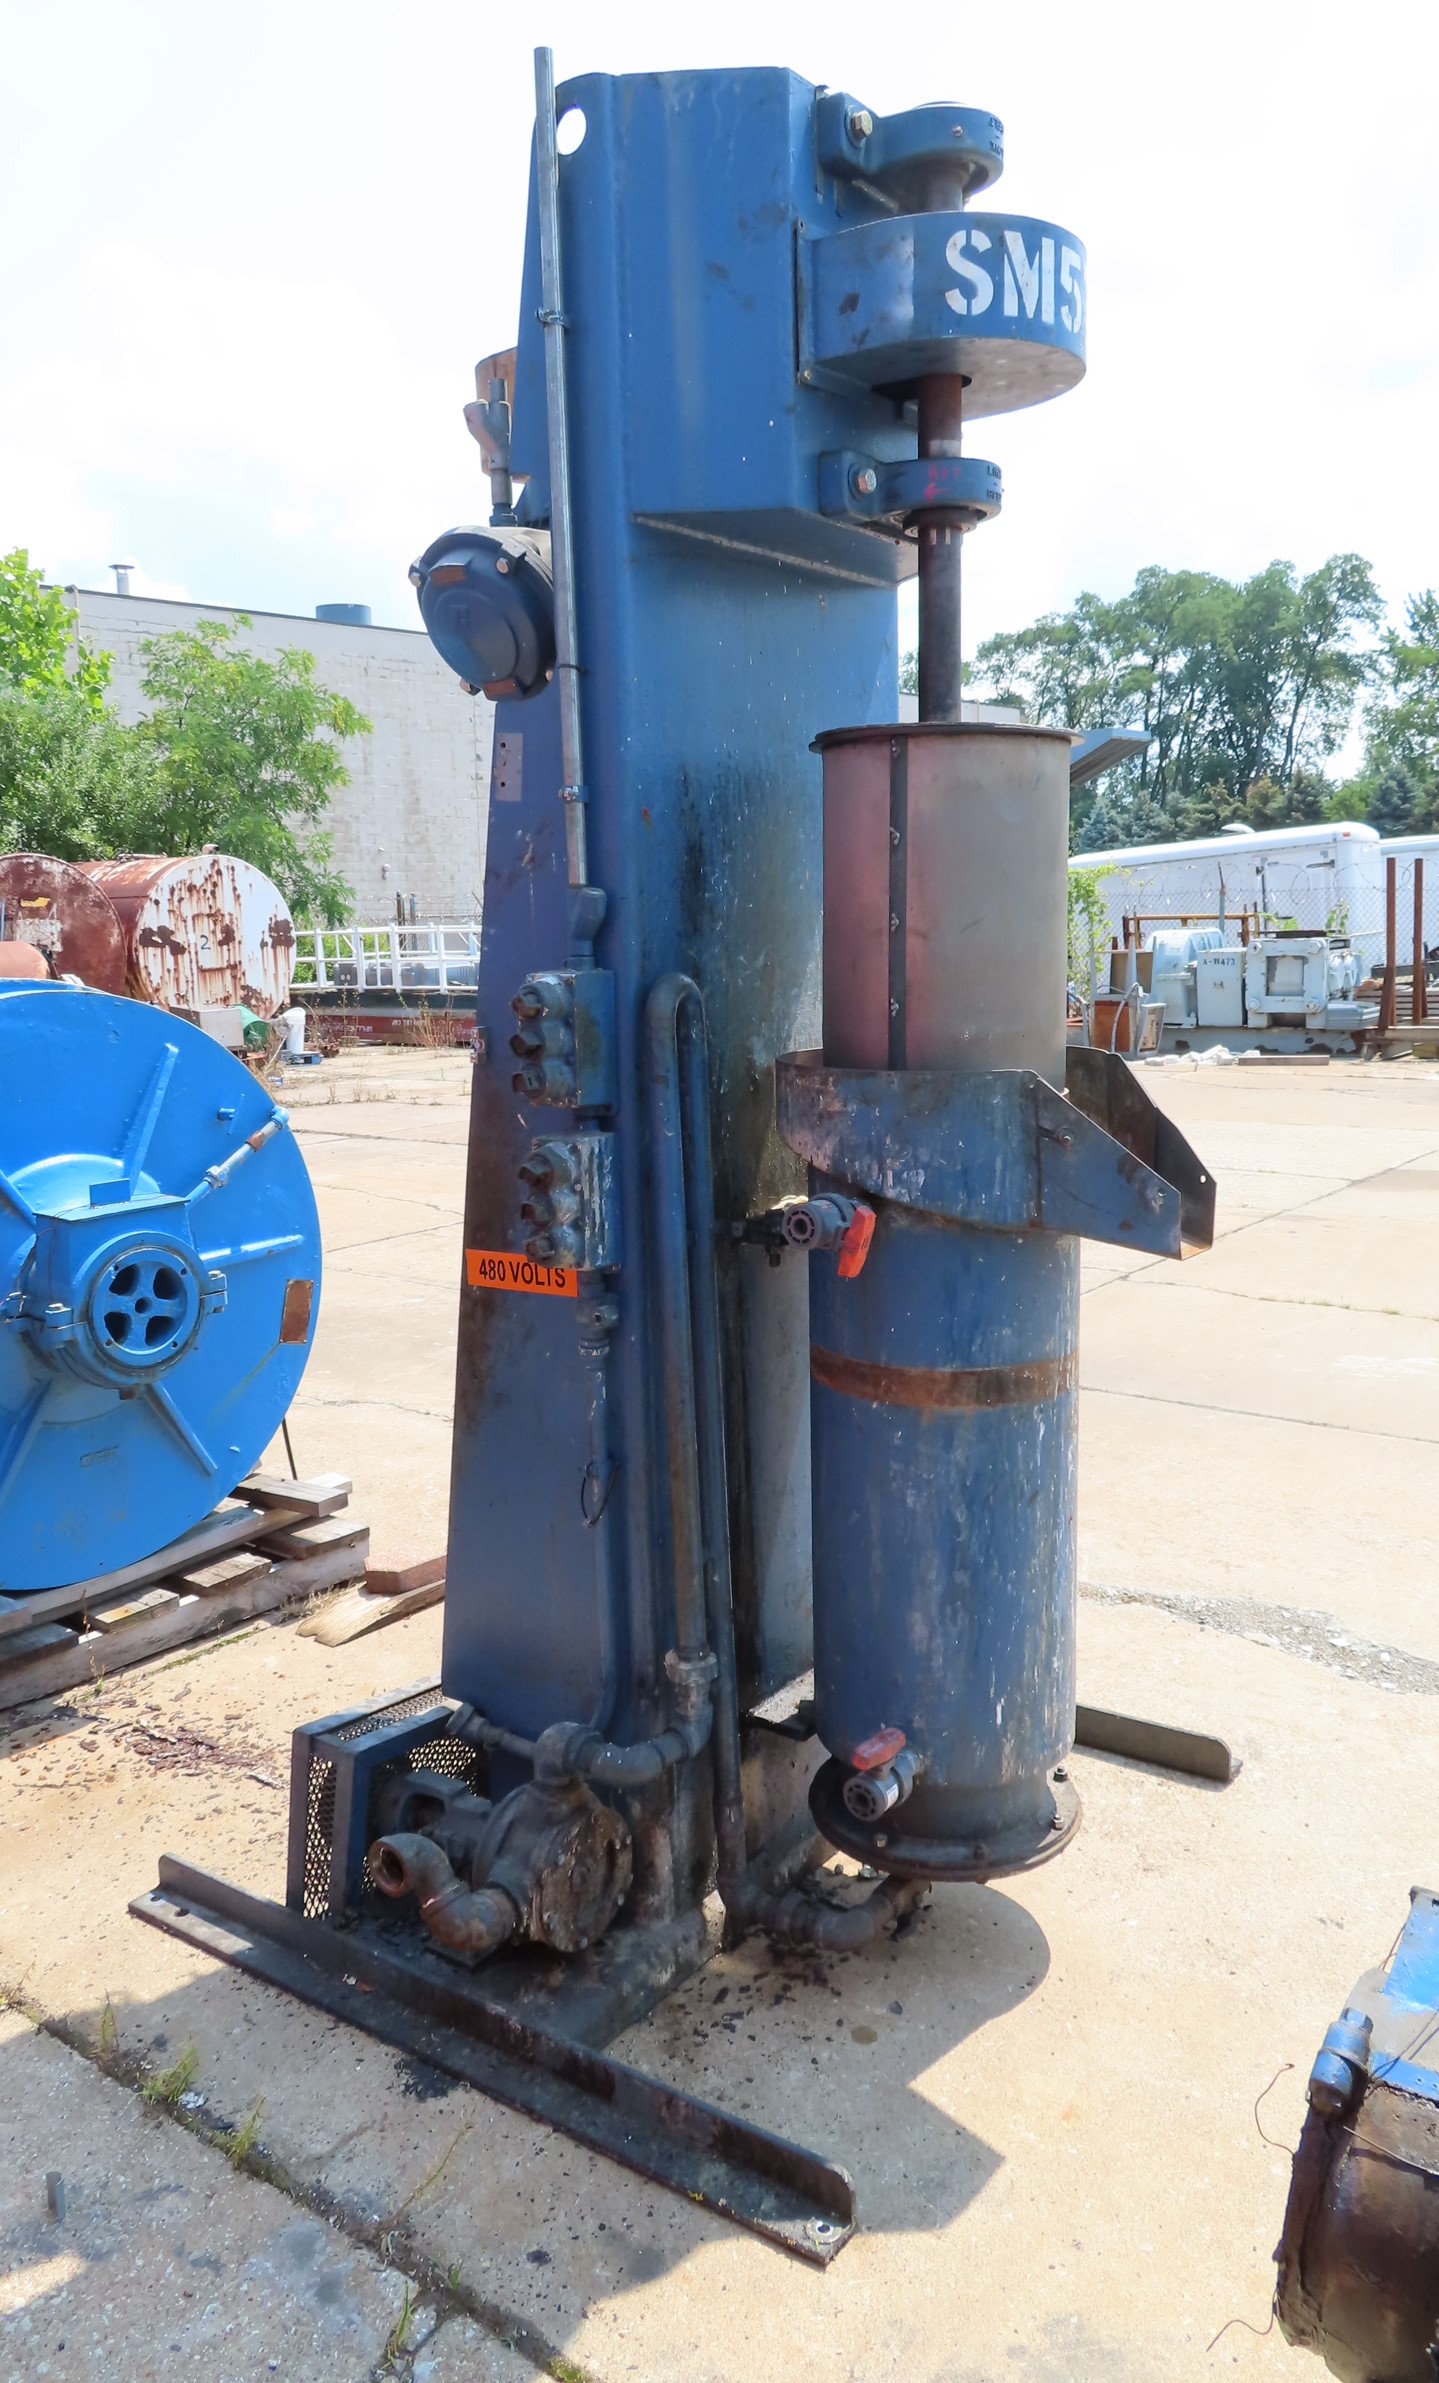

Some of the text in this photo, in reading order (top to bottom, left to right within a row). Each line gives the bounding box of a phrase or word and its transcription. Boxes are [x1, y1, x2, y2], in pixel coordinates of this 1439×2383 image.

[944, 229, 1087, 335] SM5
[200, 934, 212, 950] 2
[479, 1258, 566, 1289] 480 VOLTS
